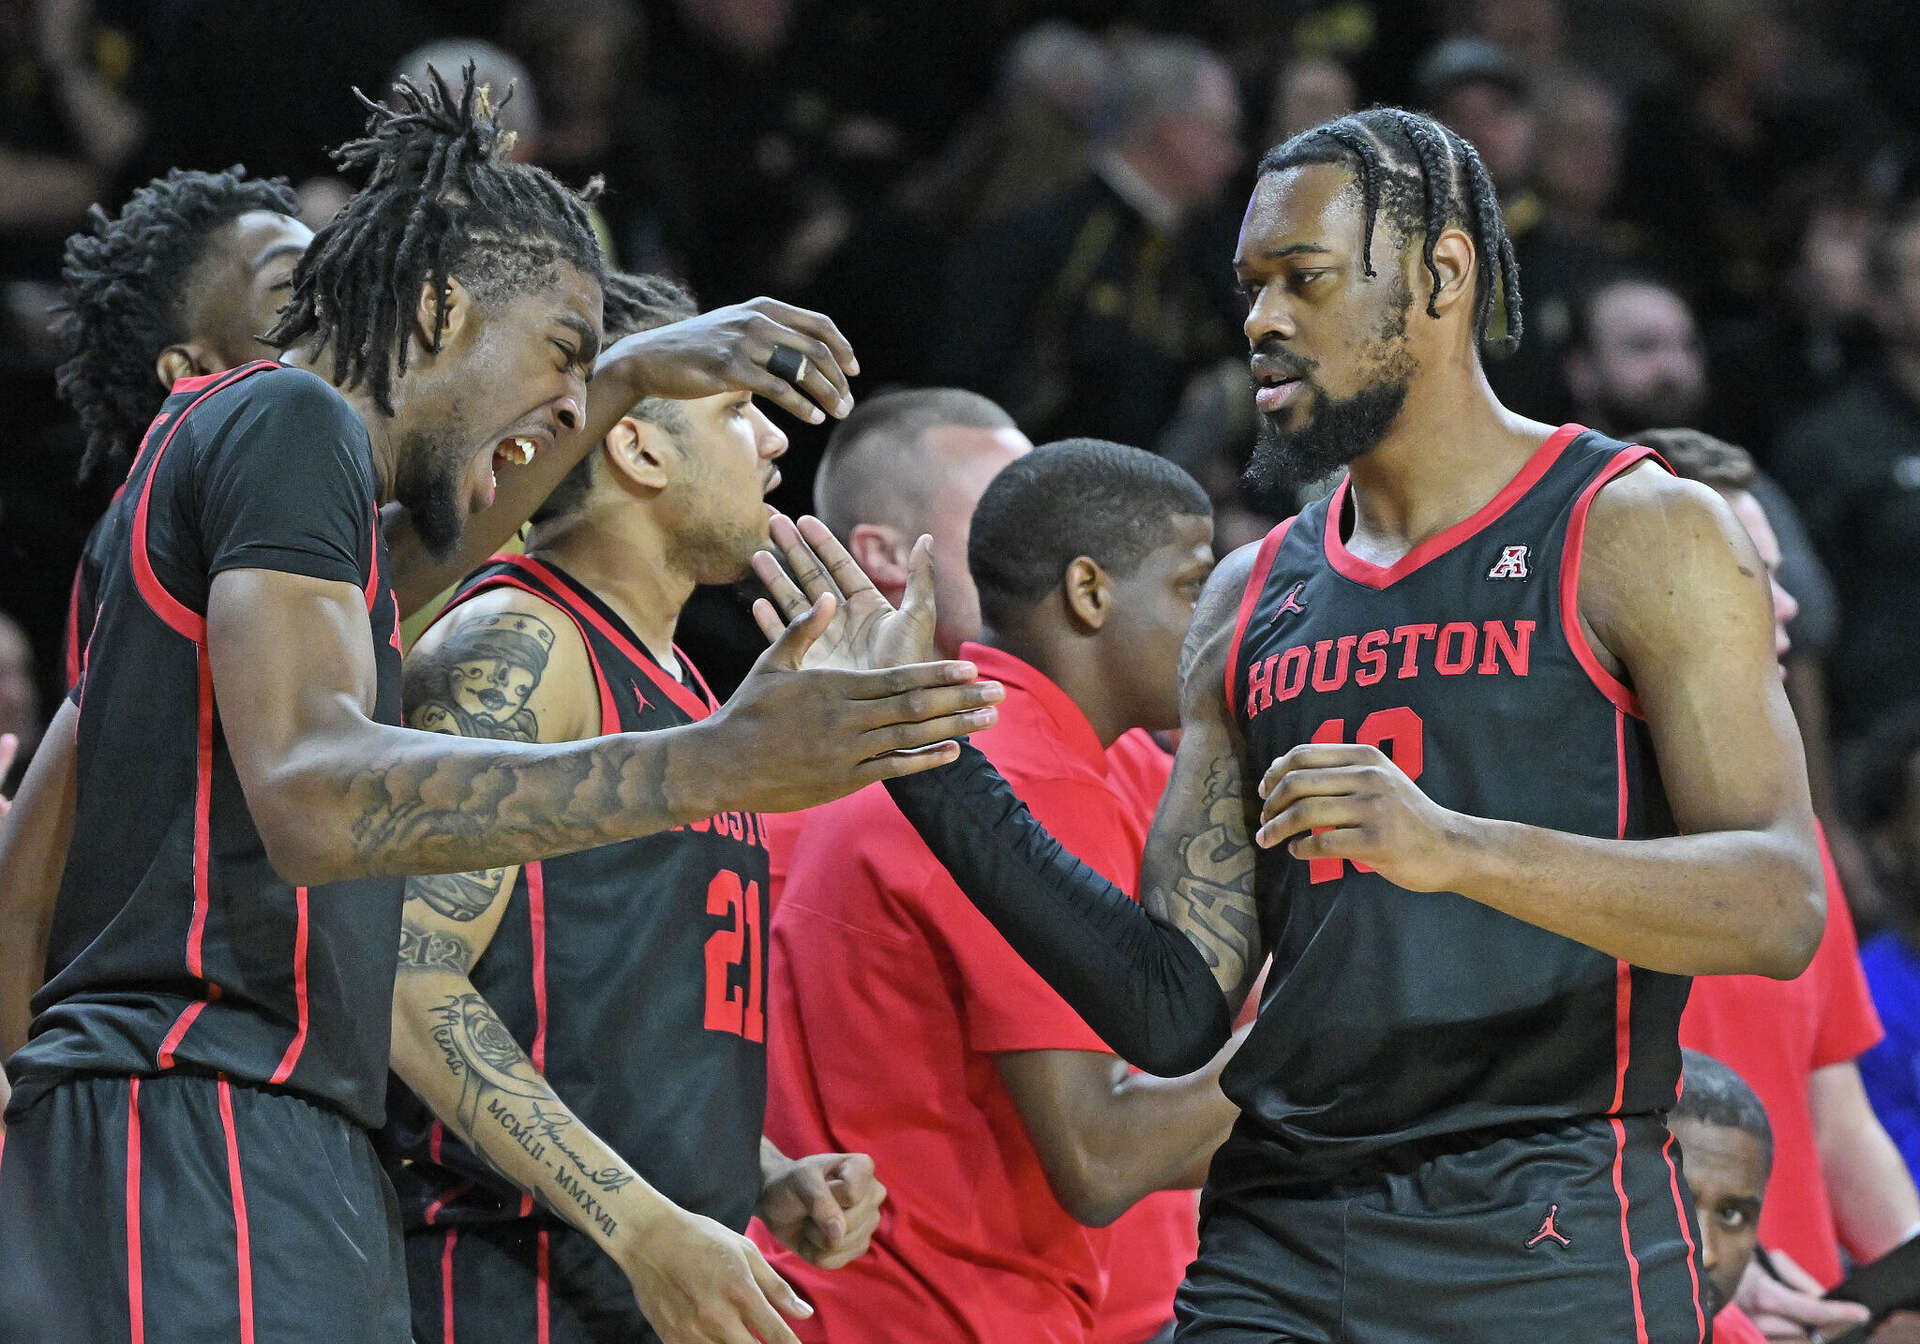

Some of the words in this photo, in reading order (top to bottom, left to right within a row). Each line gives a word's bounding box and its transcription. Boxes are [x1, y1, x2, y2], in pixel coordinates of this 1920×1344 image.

[1247, 619, 1536, 720] HOUSTON
[703, 868, 764, 1044] 21
[487, 1098, 545, 1160] MCMLII
[554, 1165, 618, 1237] MMXVII
